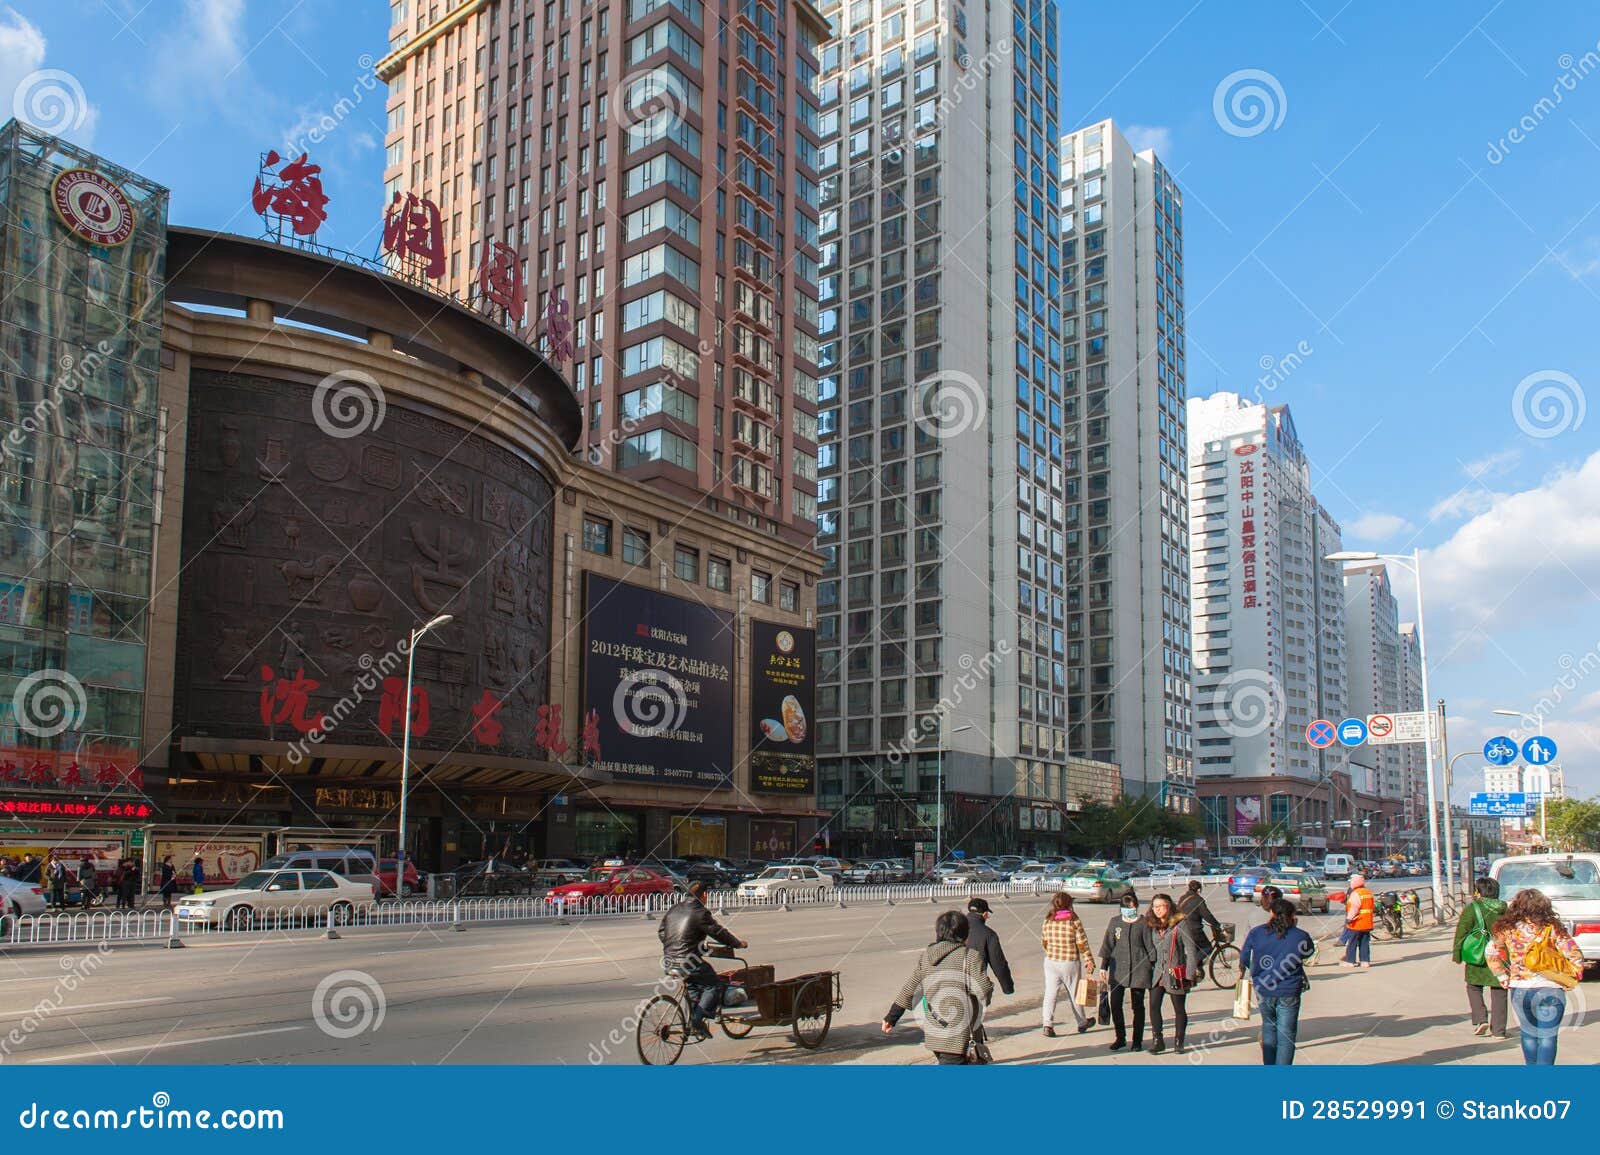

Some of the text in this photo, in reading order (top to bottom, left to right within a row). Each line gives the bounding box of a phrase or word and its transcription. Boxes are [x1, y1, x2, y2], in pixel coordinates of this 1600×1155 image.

[57, 172, 132, 240] PILSEN BEER BBQ BUFFET
[1240, 459, 1257, 609] 沈阳中山皇冠假日酒店
[591, 640, 729, 681] 2012年珠宝及艺术品拍卖会
